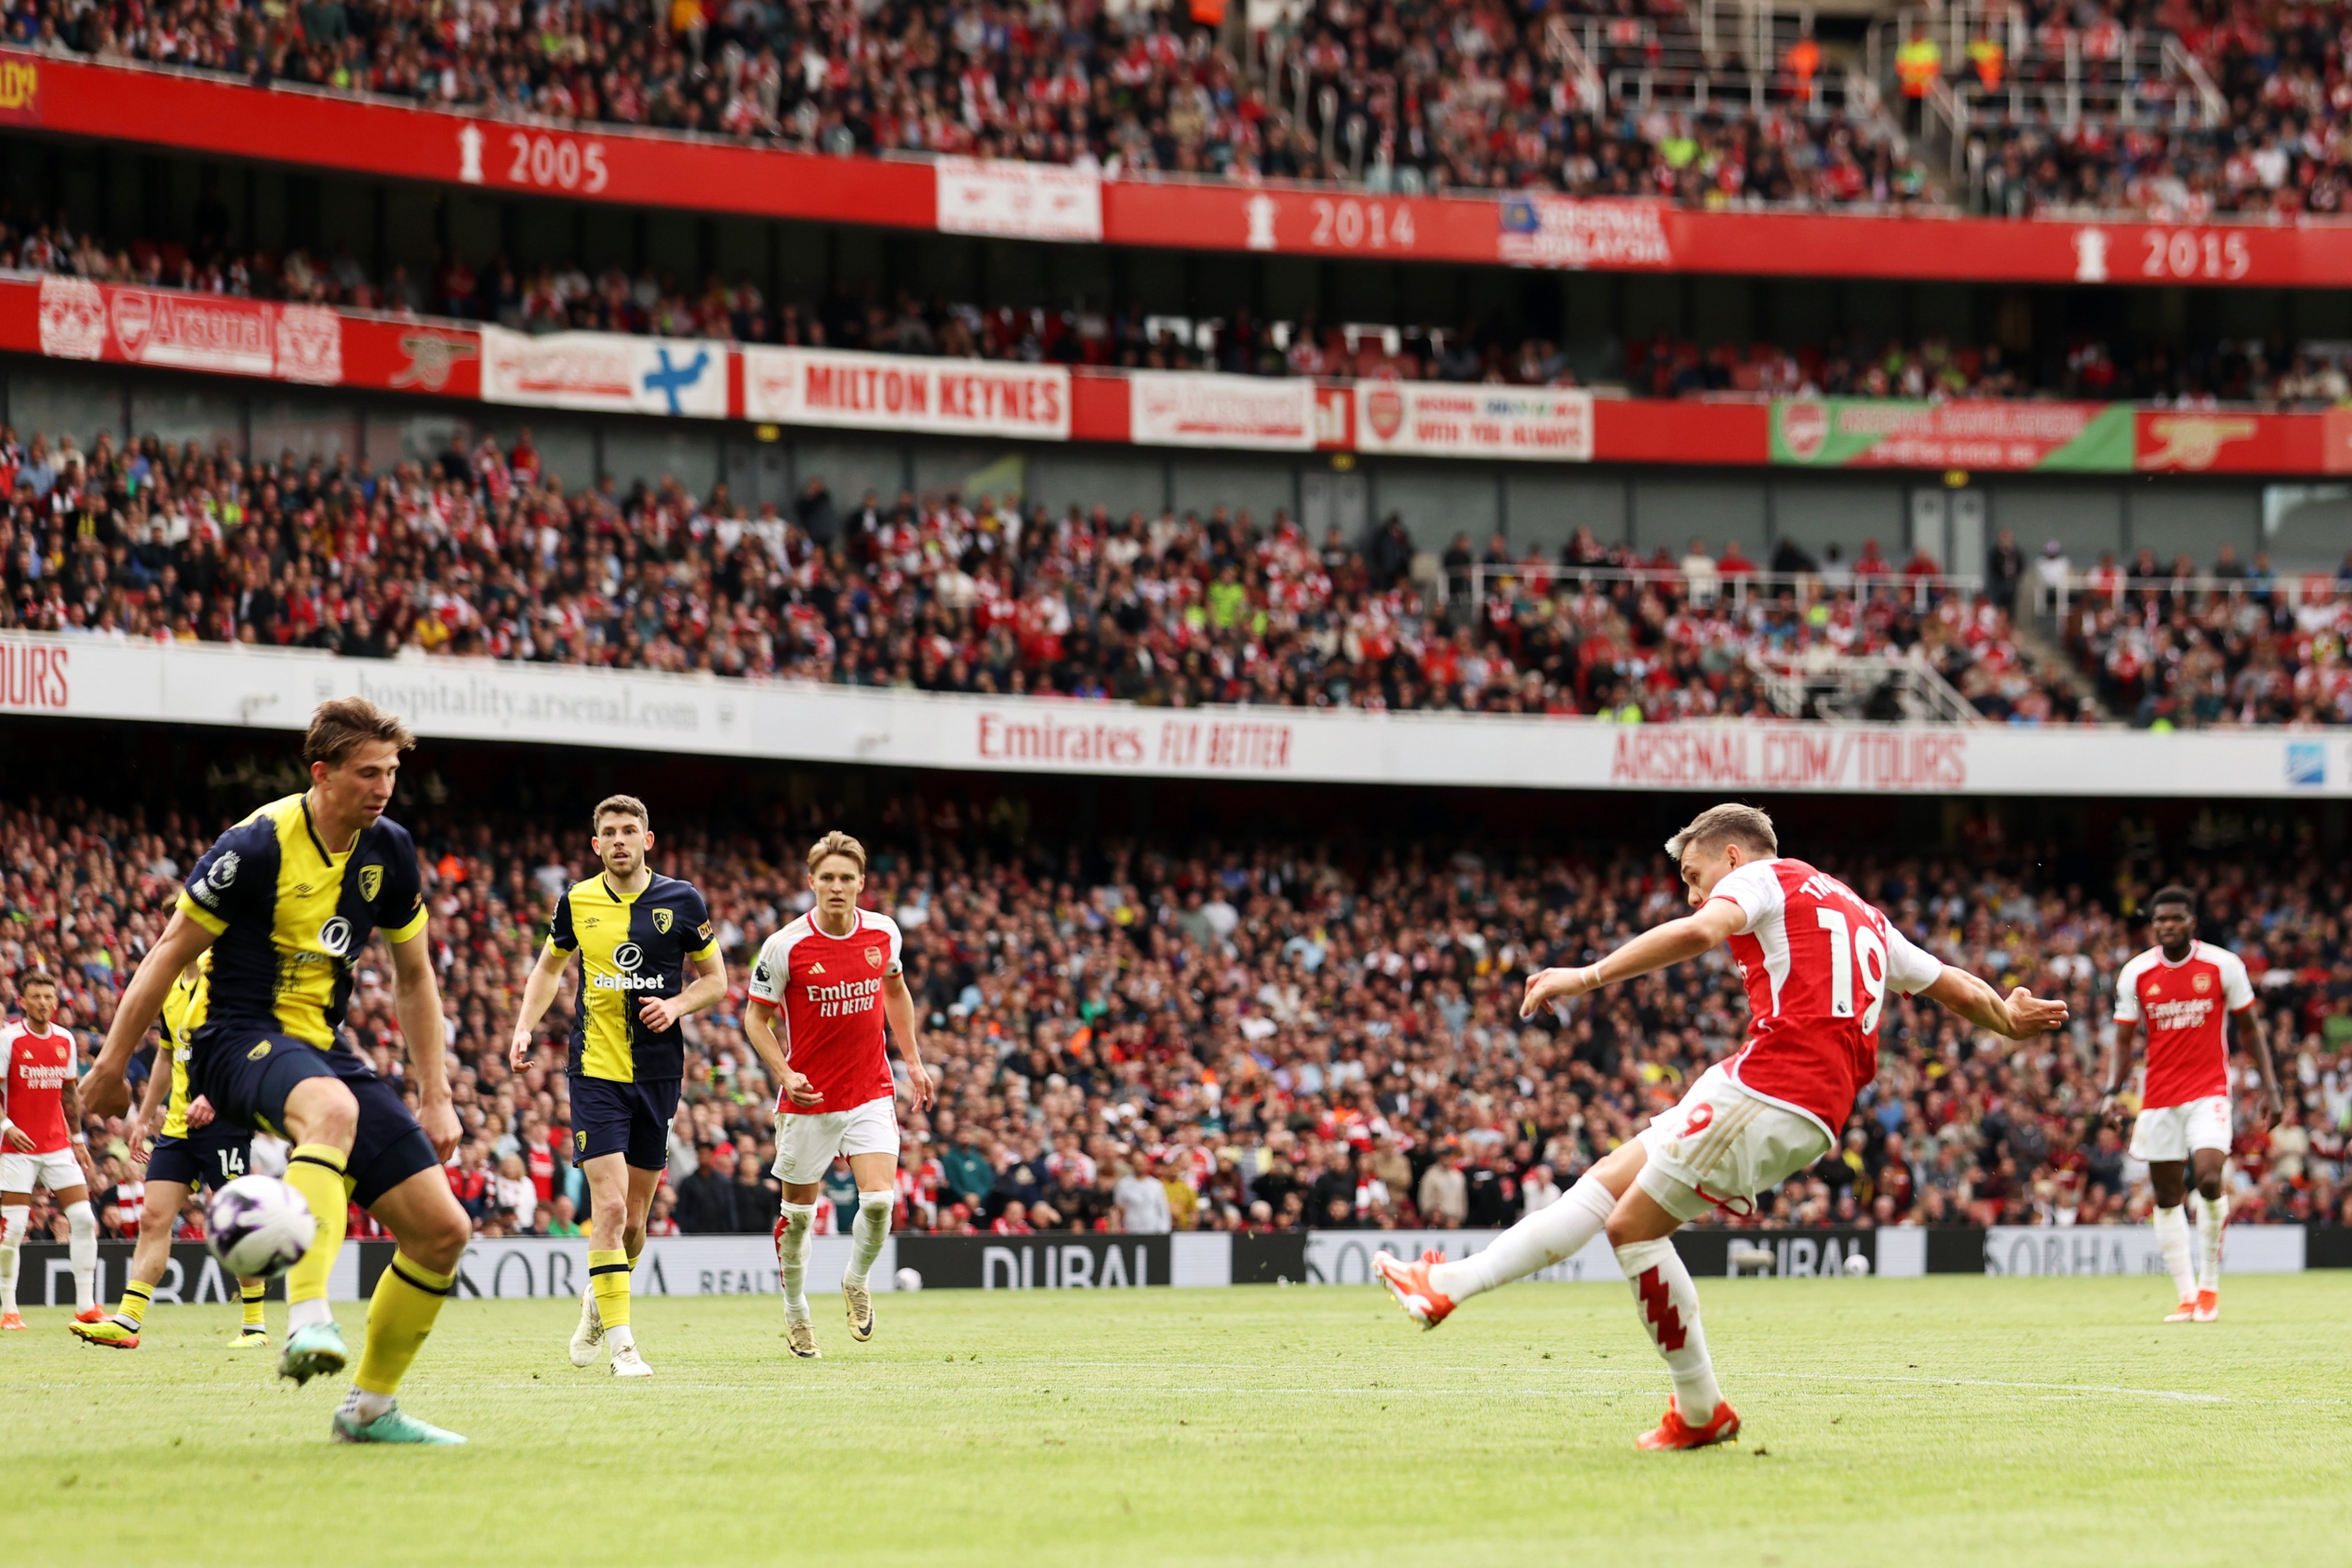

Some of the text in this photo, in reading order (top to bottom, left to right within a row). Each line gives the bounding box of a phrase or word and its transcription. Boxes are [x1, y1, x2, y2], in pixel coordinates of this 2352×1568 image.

[508, 132, 609, 193] 2005
[1310, 199, 1415, 250] 2014
[2142, 231, 2250, 280] 2015
[806, 365, 1061, 423] MILTON KEYNES
[357, 669, 699, 731] hospitality.arsenal.com
[977, 712, 1293, 768] Emirates FLY BETTER
[1610, 730, 1967, 788] ARSENAL.COM/TOURS
[593, 972, 664, 992] dafabet
[806, 977, 883, 1002] Emirate
[1816, 907, 1887, 1036] 19
[820, 995, 875, 1017] FLY BETTER
[217, 1147, 245, 1176] 14
[459, 1248, 780, 1297] SOBA REALT
[982, 1244, 1147, 1290] DUBAI
